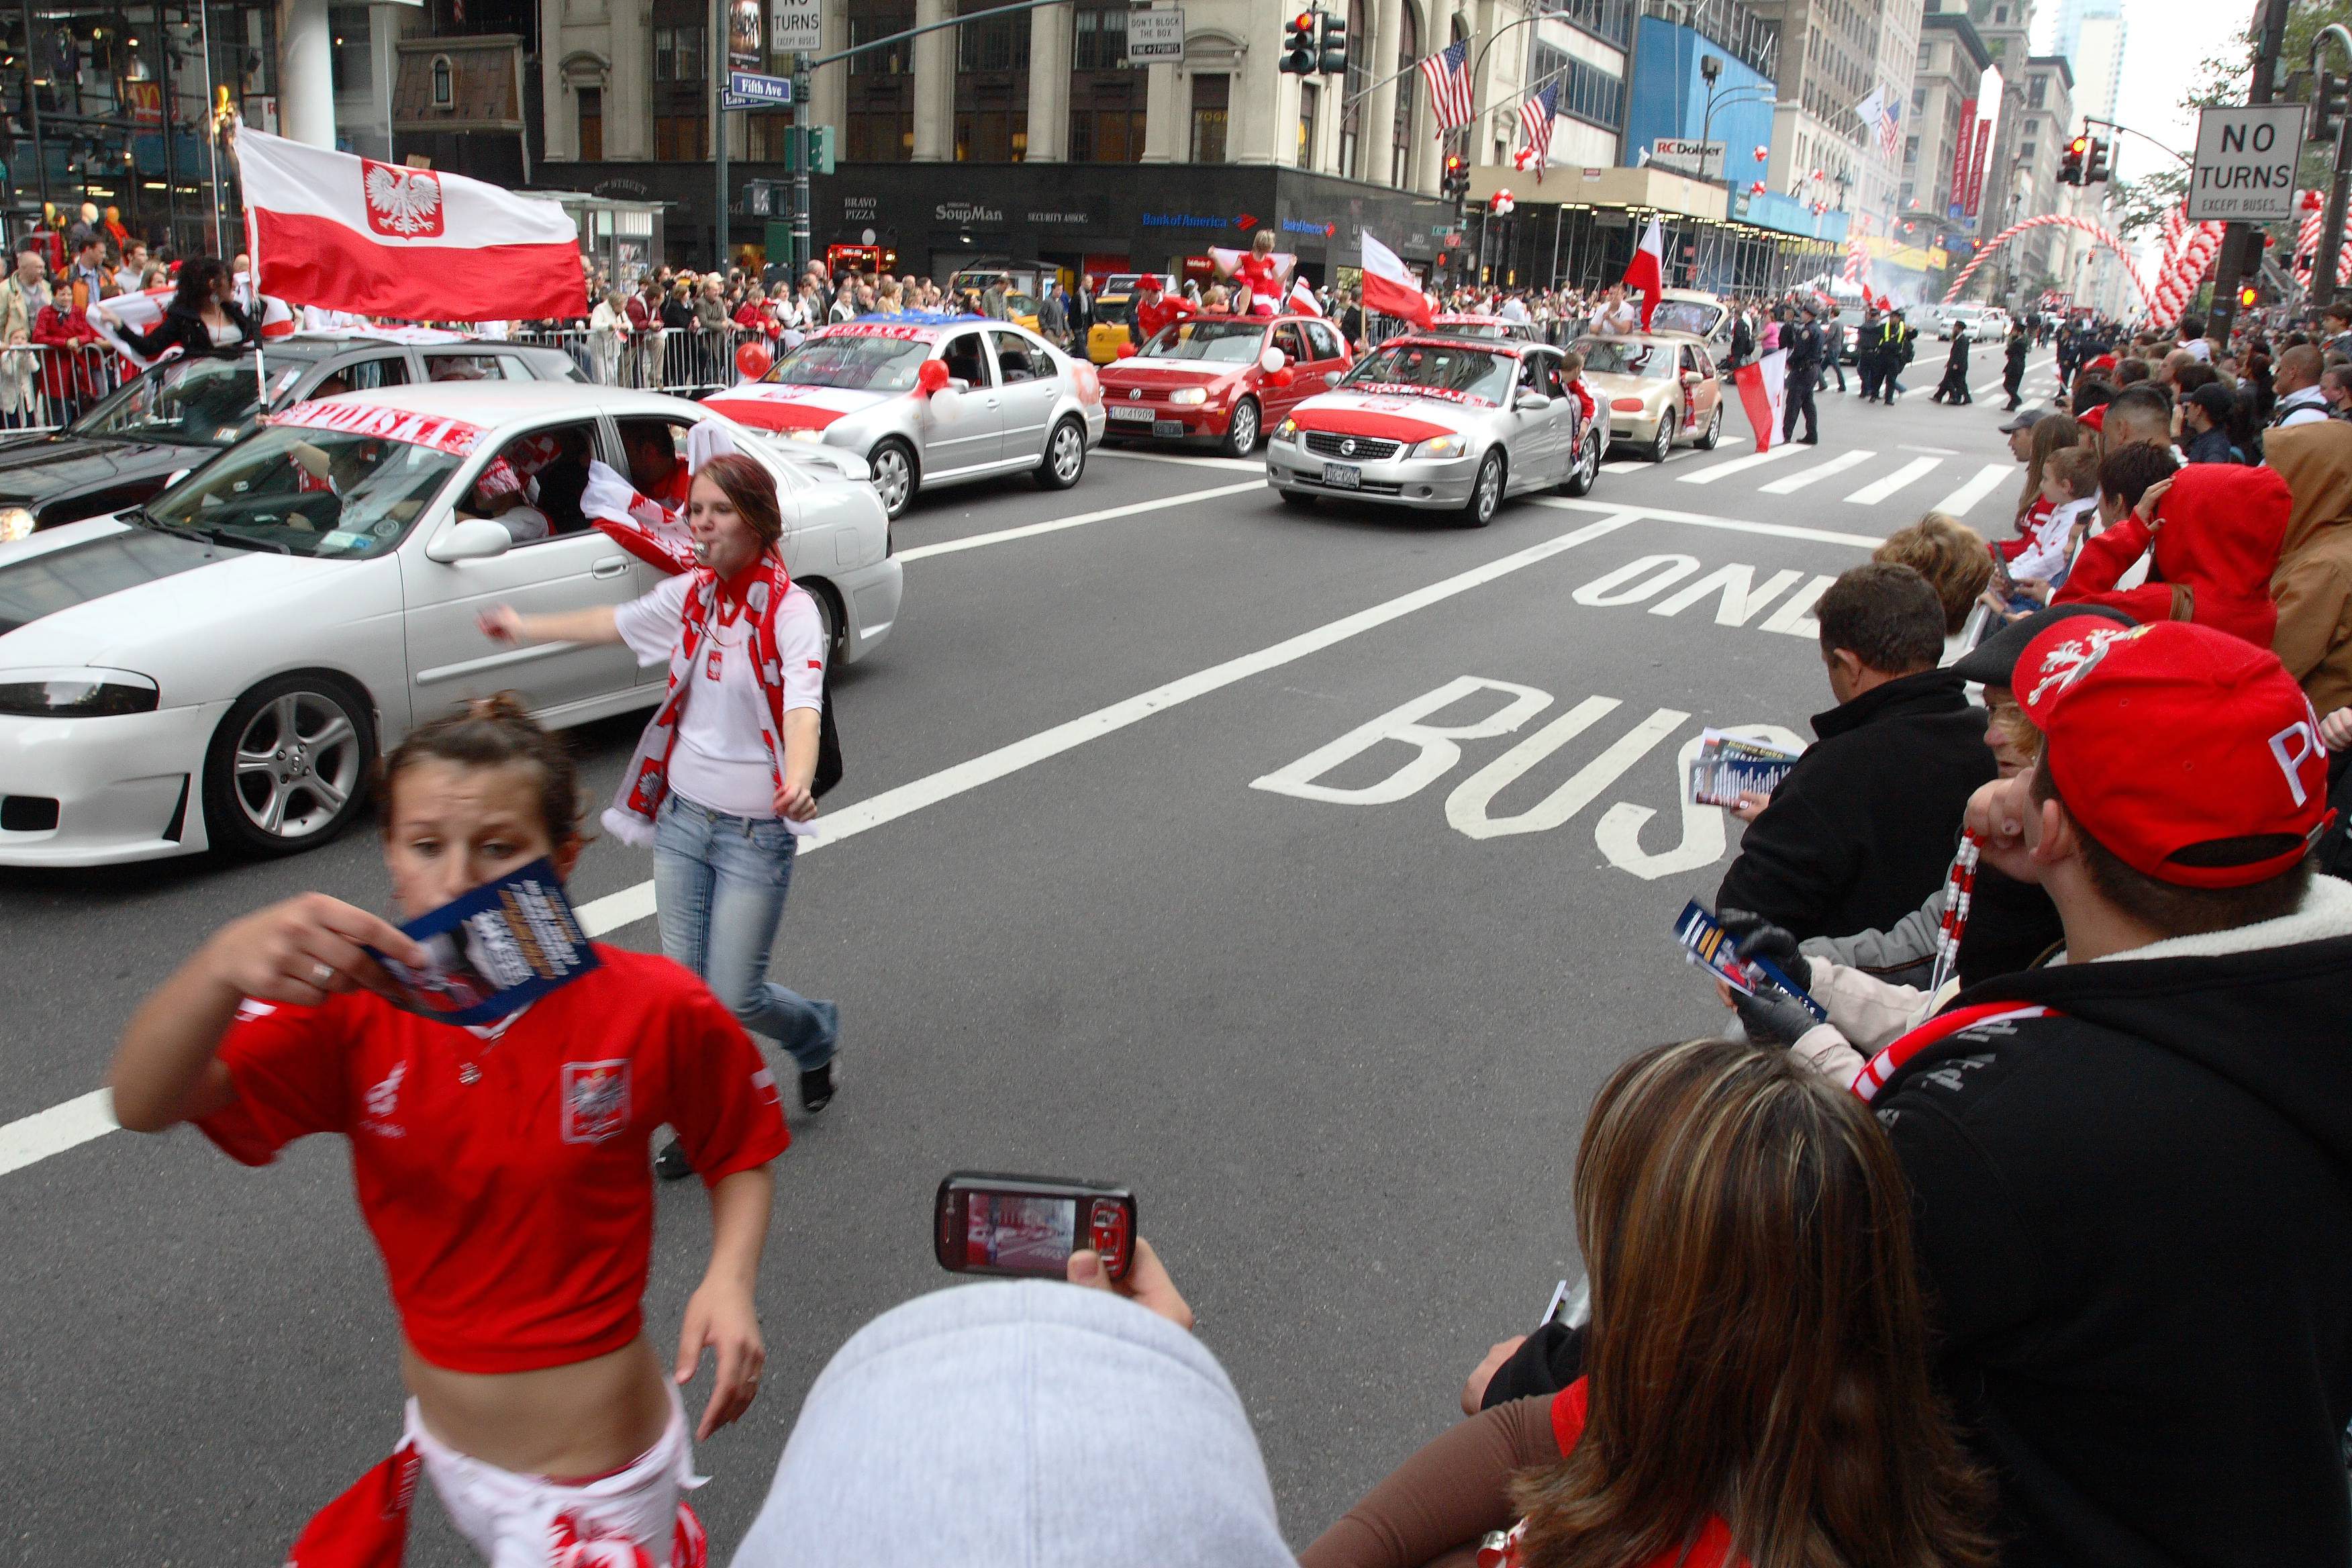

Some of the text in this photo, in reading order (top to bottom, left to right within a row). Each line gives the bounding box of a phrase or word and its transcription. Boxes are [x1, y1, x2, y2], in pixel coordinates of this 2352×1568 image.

[774, 13, 819, 31] TURNS
[1155, 17, 1179, 27] BLOCK
[1140, 29, 1171, 38] THE BOX
[742, 78, 782, 97] Fifth Ave
[2221, 124, 2275, 152] NO
[1657, 142, 1723, 156] RC Doler
[2199, 164, 2290, 189] TURNS
[844, 197, 877, 208] BRAVO
[2202, 198, 2275, 211] EXCEPT BUSES
[845, 209, 875, 220] PIZZA
[935, 203, 1003, 222] SoupMan
[1028, 213, 1062, 222] SECURITY
[305, 403, 457, 448] POLSKA
[1248, 675, 1812, 880] BUS
